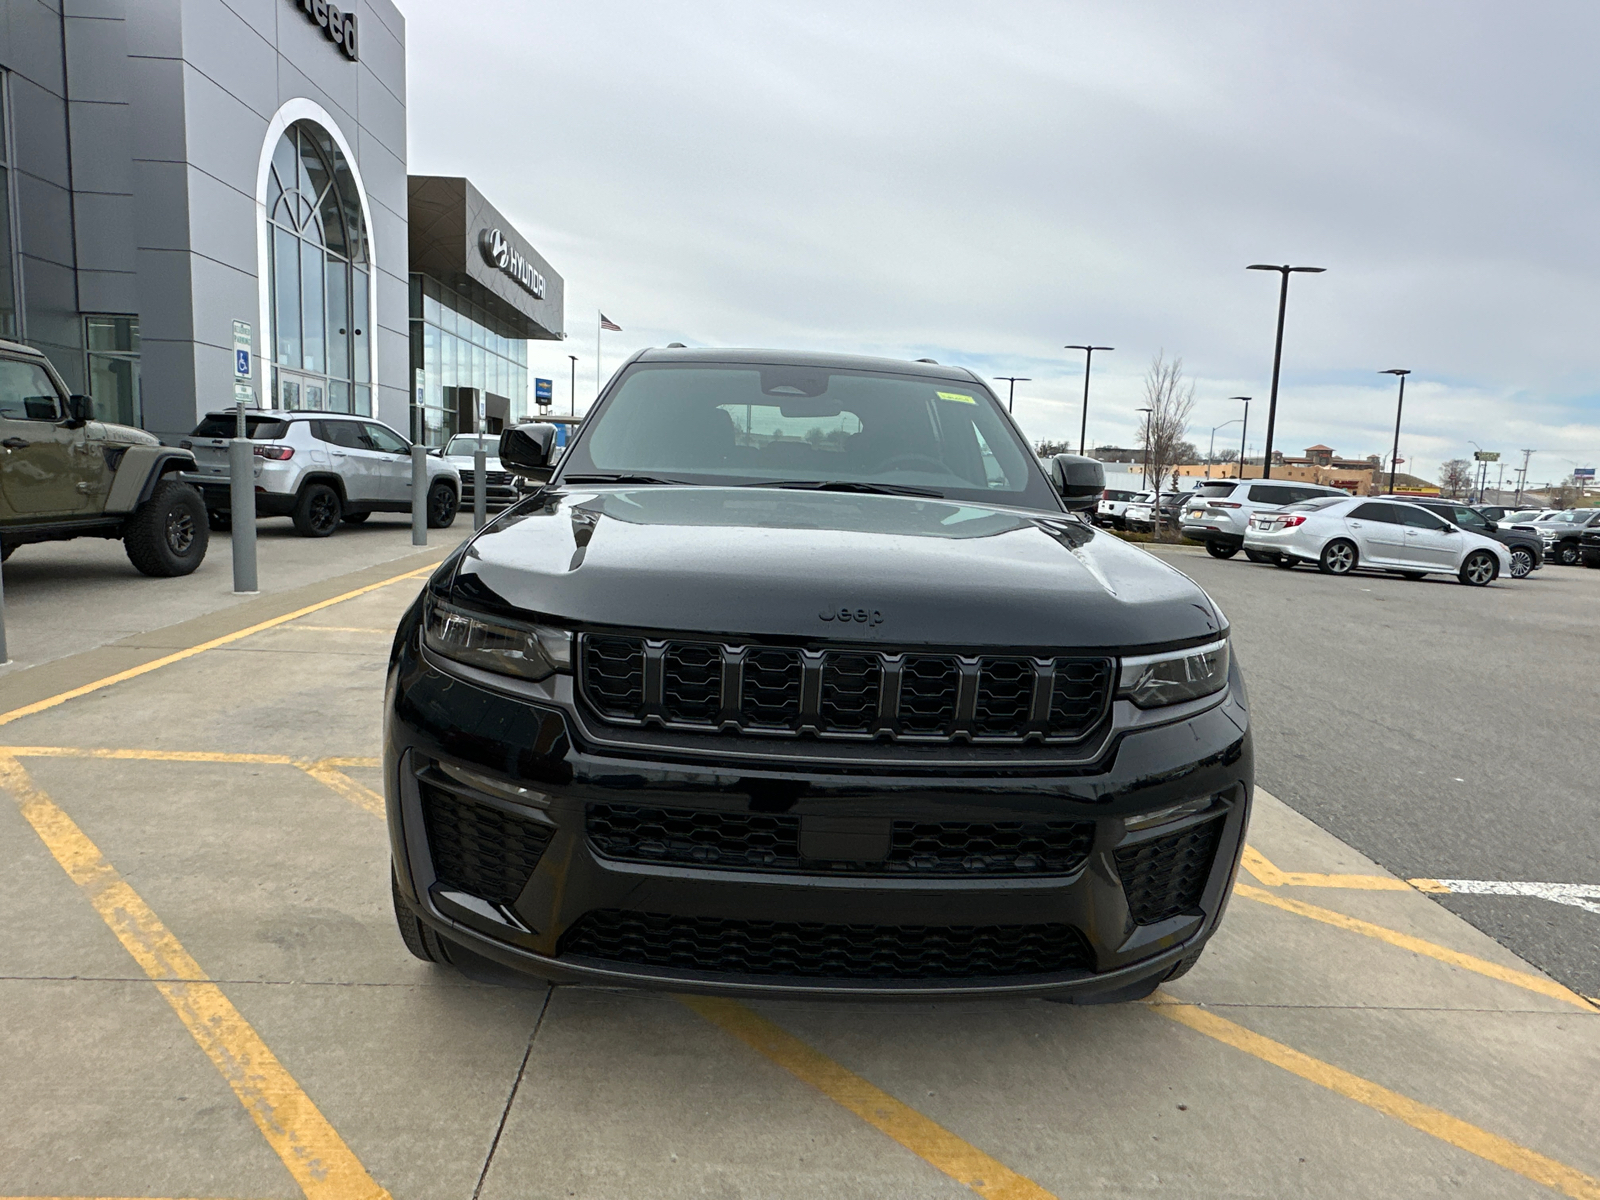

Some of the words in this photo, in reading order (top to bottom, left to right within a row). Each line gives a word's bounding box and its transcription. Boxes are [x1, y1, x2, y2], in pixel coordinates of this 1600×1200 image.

[303, 0, 359, 61] eed
[510, 246, 546, 300] HYUNDAI
[819, 604, 884, 627] Jeep
